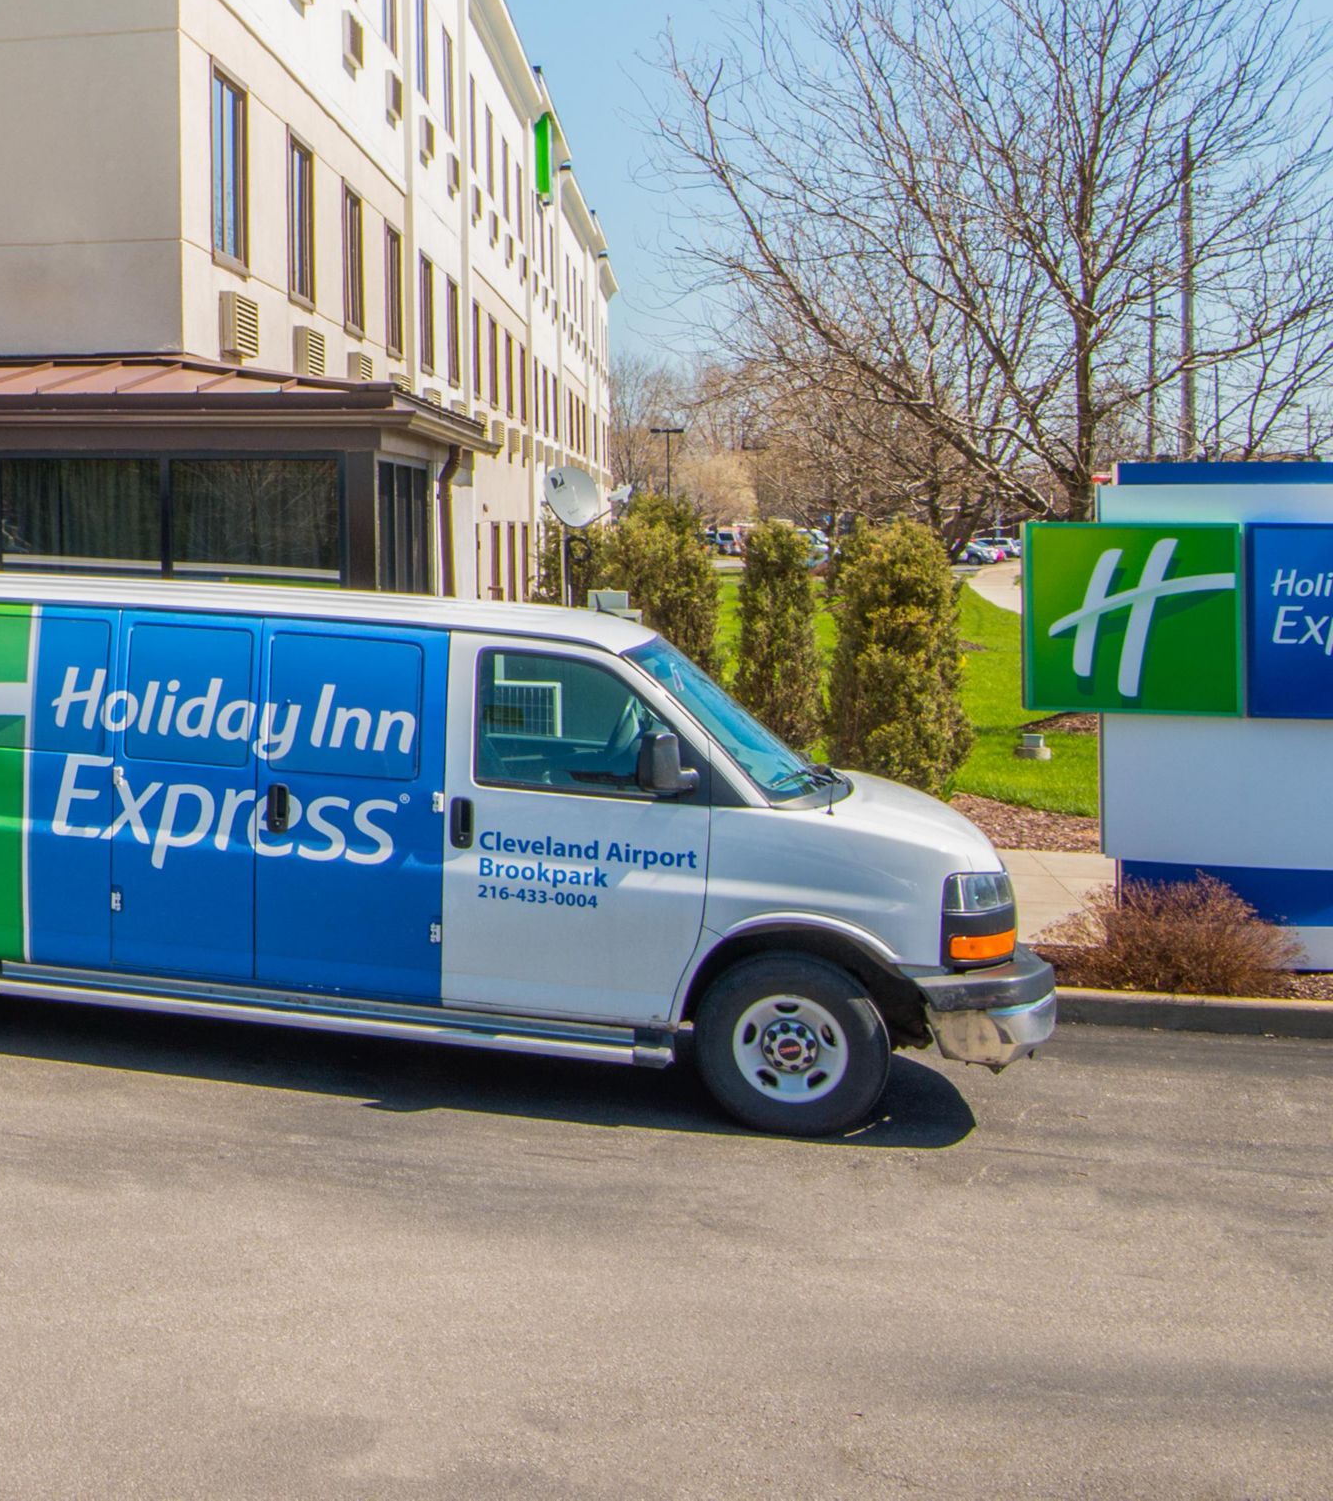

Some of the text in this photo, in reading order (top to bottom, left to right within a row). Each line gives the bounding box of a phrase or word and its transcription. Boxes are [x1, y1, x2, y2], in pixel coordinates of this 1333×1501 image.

[51, 666, 417, 761] Holiday Inn
[51, 753, 399, 869] Express
[479, 831, 697, 870] Cleveland Airport
[479, 857, 608, 888] Brookpark
[477, 884, 598, 908] 216-433-0004
